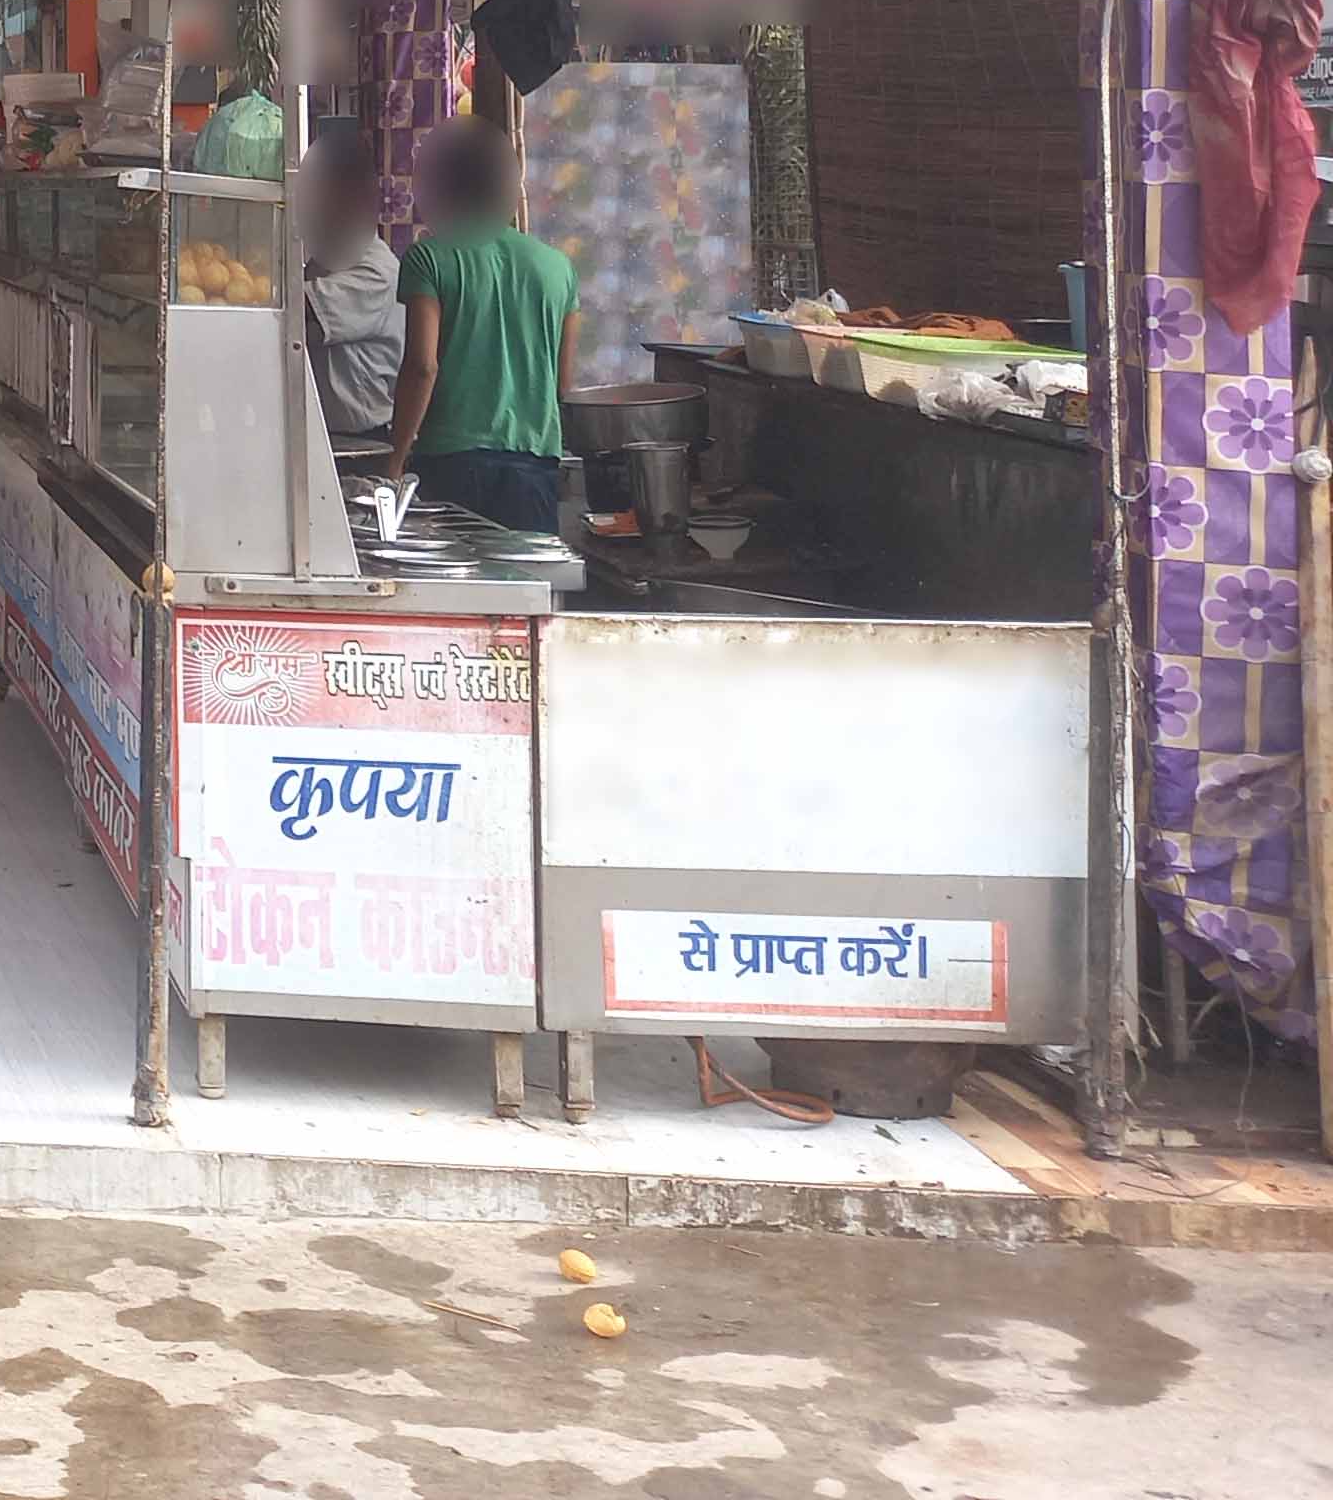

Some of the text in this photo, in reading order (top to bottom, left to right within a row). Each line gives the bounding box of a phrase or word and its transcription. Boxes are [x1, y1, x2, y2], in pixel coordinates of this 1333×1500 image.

[323, 640, 405, 709] स्वीट्स
[412, 653, 446, 699] एवं
[270, 756, 461, 840] कृपया
[678, 920, 719, 972] से
[730, 933, 828, 978] प्राप्त
